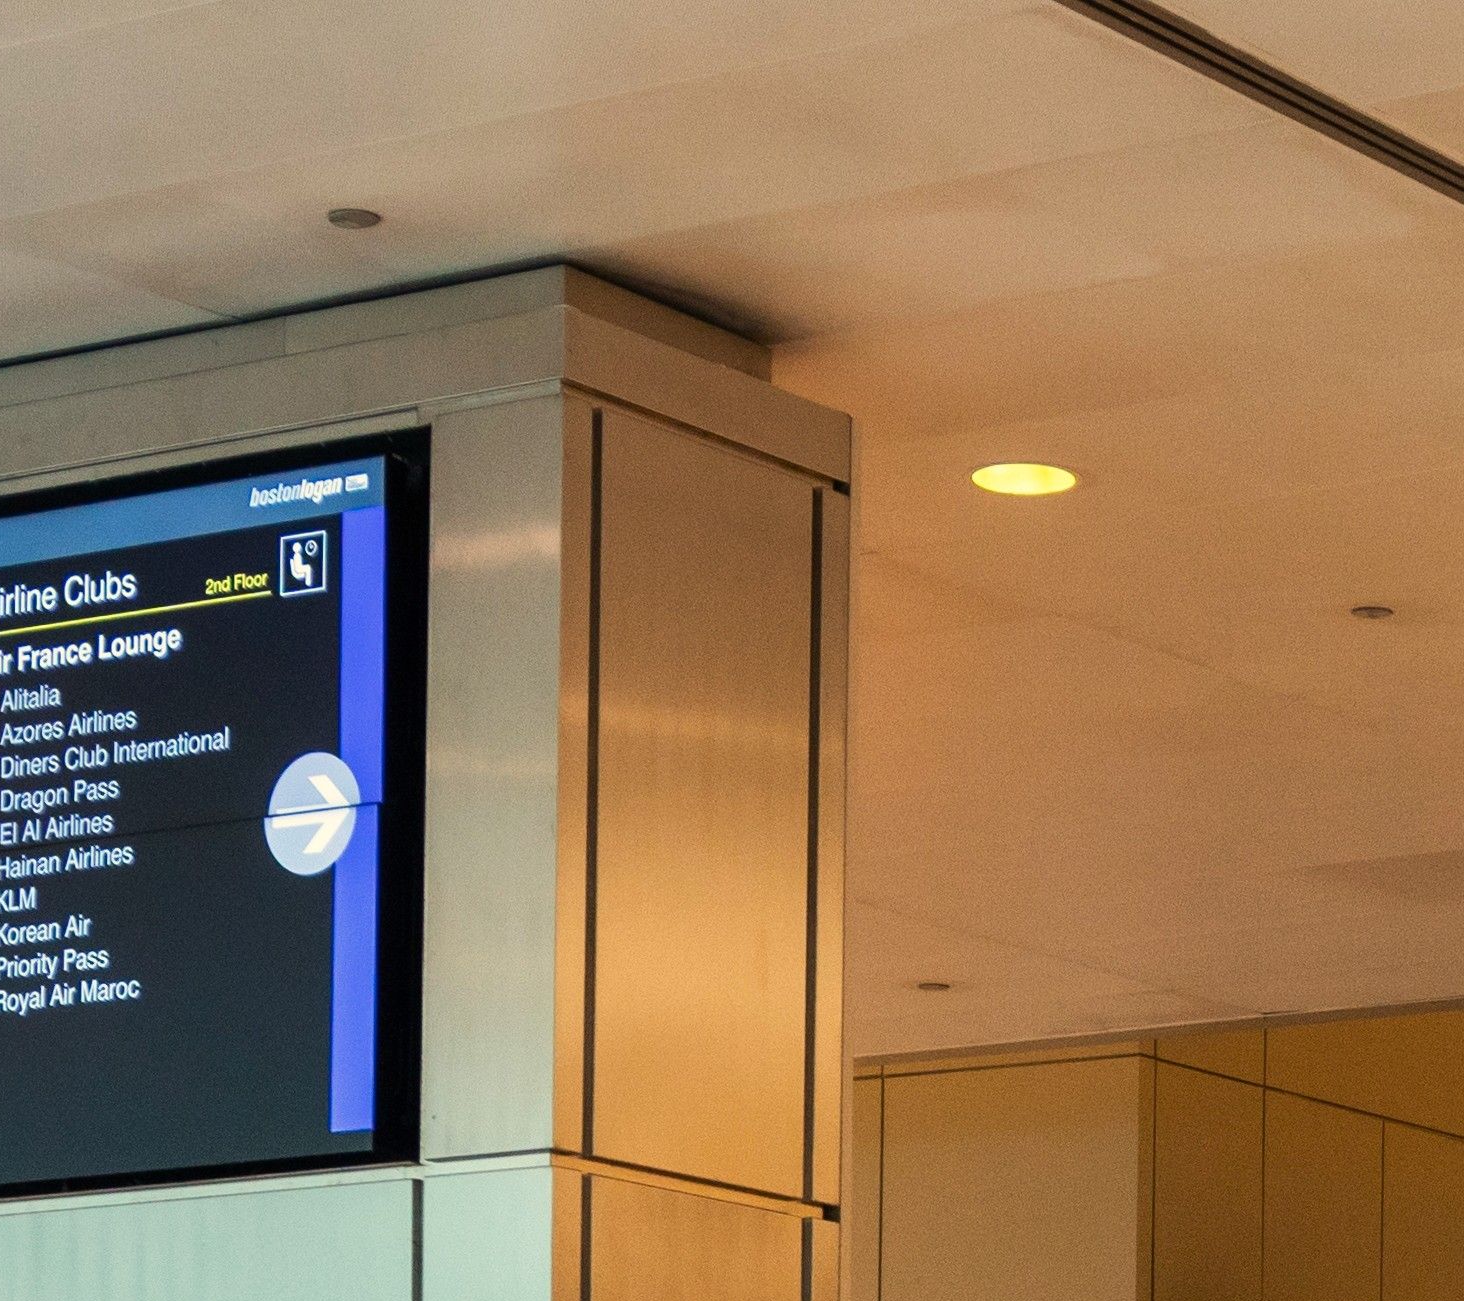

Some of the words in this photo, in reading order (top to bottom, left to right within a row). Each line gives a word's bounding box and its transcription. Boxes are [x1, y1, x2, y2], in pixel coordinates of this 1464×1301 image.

[250, 476, 343, 507] bostonlogan
[64, 571, 137, 606] Clubs
[206, 577, 231, 595] 2nd
[234, 572, 268, 591] Floor
[18, 640, 91, 672] France
[98, 627, 182, 660] Lounge
[1, 685, 61, 713] Alitalia
[0, 720, 63, 746] Azores
[69, 710, 137, 737] Airlines
[0, 754, 59, 779] Diners
[65, 746, 108, 771] Club
[113, 726, 230, 764] International
[0, 787, 68, 813] Dragon
[73, 780, 120, 802] Pass
[0, 823, 17, 844] El
[23, 819, 41, 842] Al
[45, 813, 114, 839] Airlines
[65, 846, 135, 871] Airlines
[65, 915, 92, 937] Air
[64, 949, 109, 971] Pass
[50, 984, 75, 1006] Air
[81, 979, 140, 1003] Maroc
